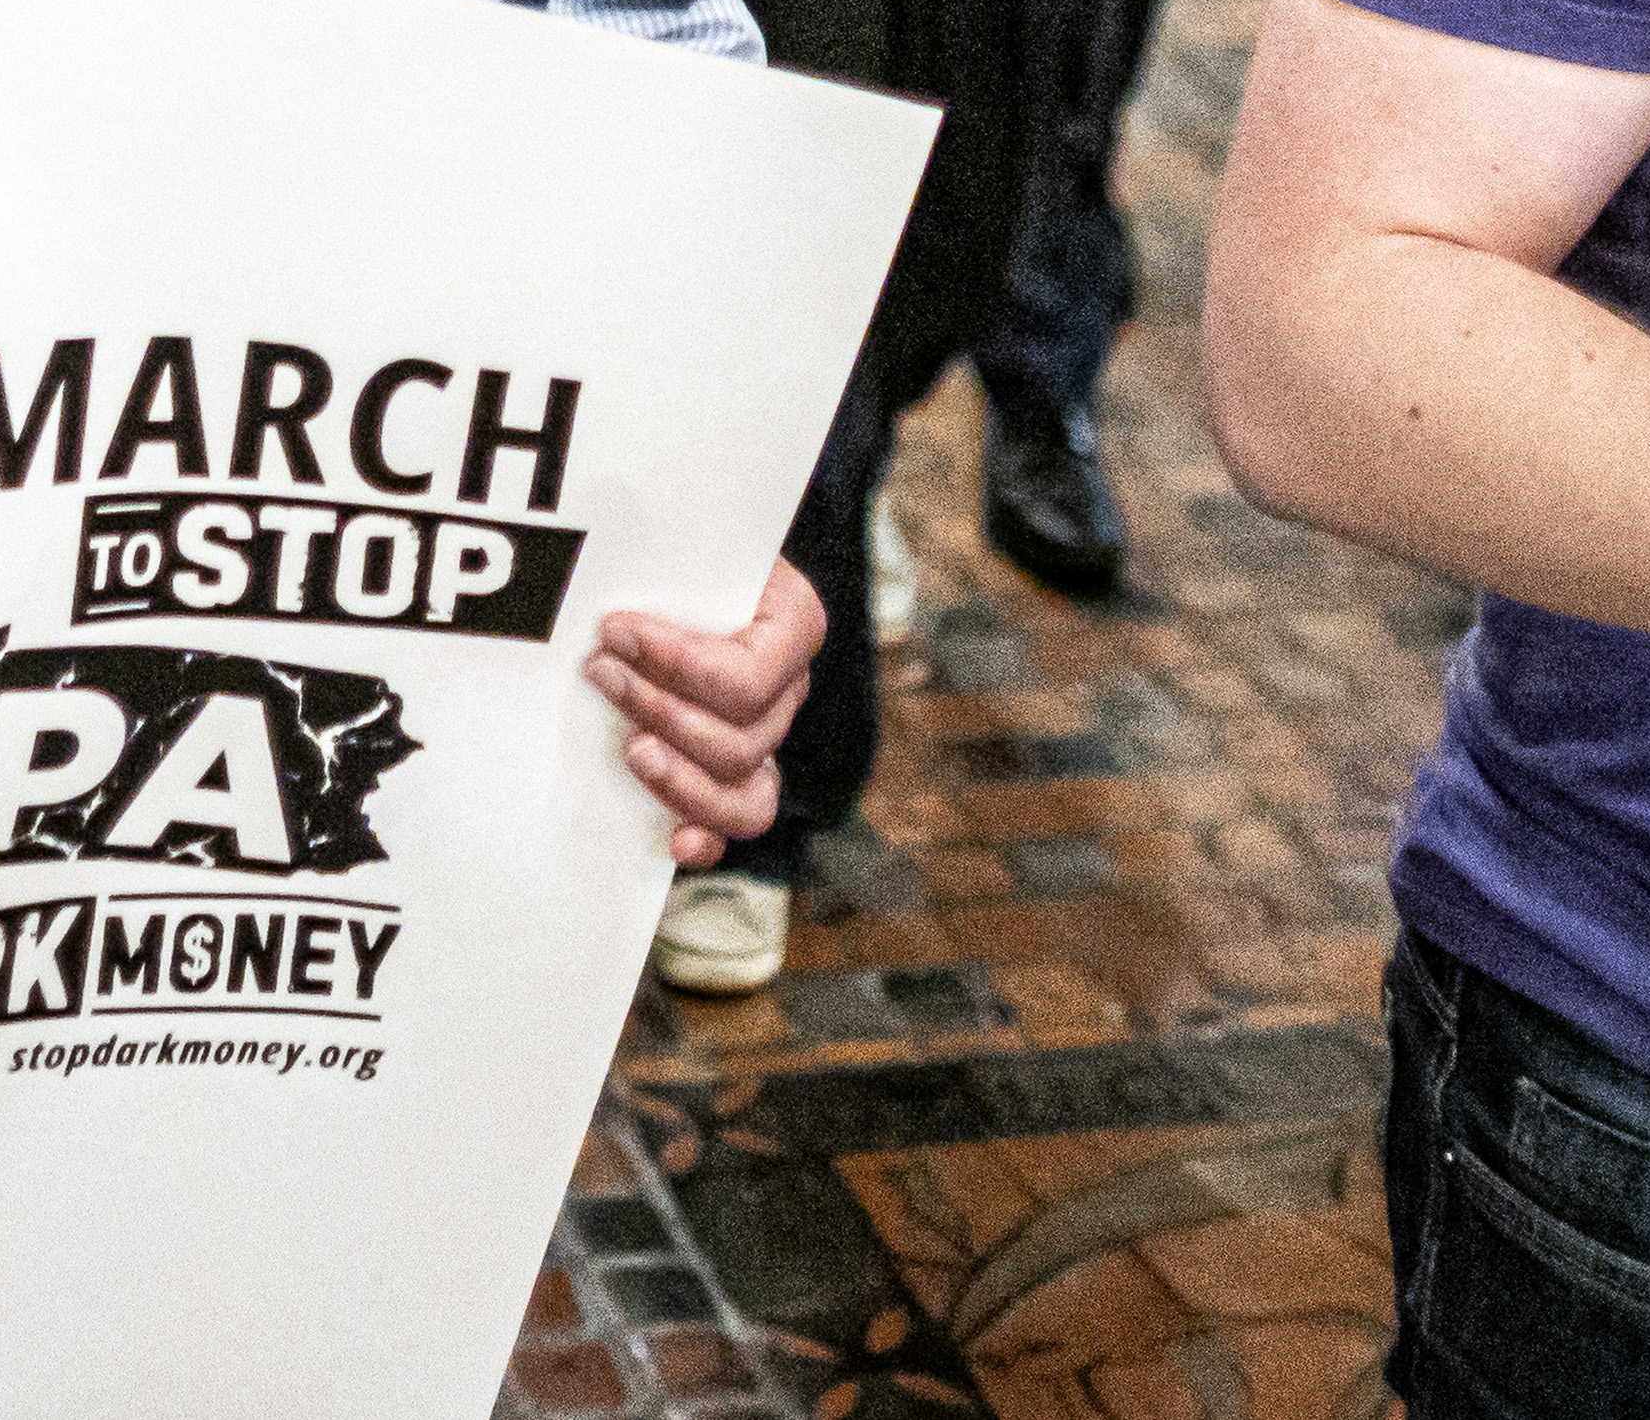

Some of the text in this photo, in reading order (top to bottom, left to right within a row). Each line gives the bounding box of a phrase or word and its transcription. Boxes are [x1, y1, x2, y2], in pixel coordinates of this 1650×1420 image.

[89, 504, 515, 623] TO STOP
[99, 913, 402, 1001] MONEY
[8, 1033, 385, 1081] stopdarkmoney.org
